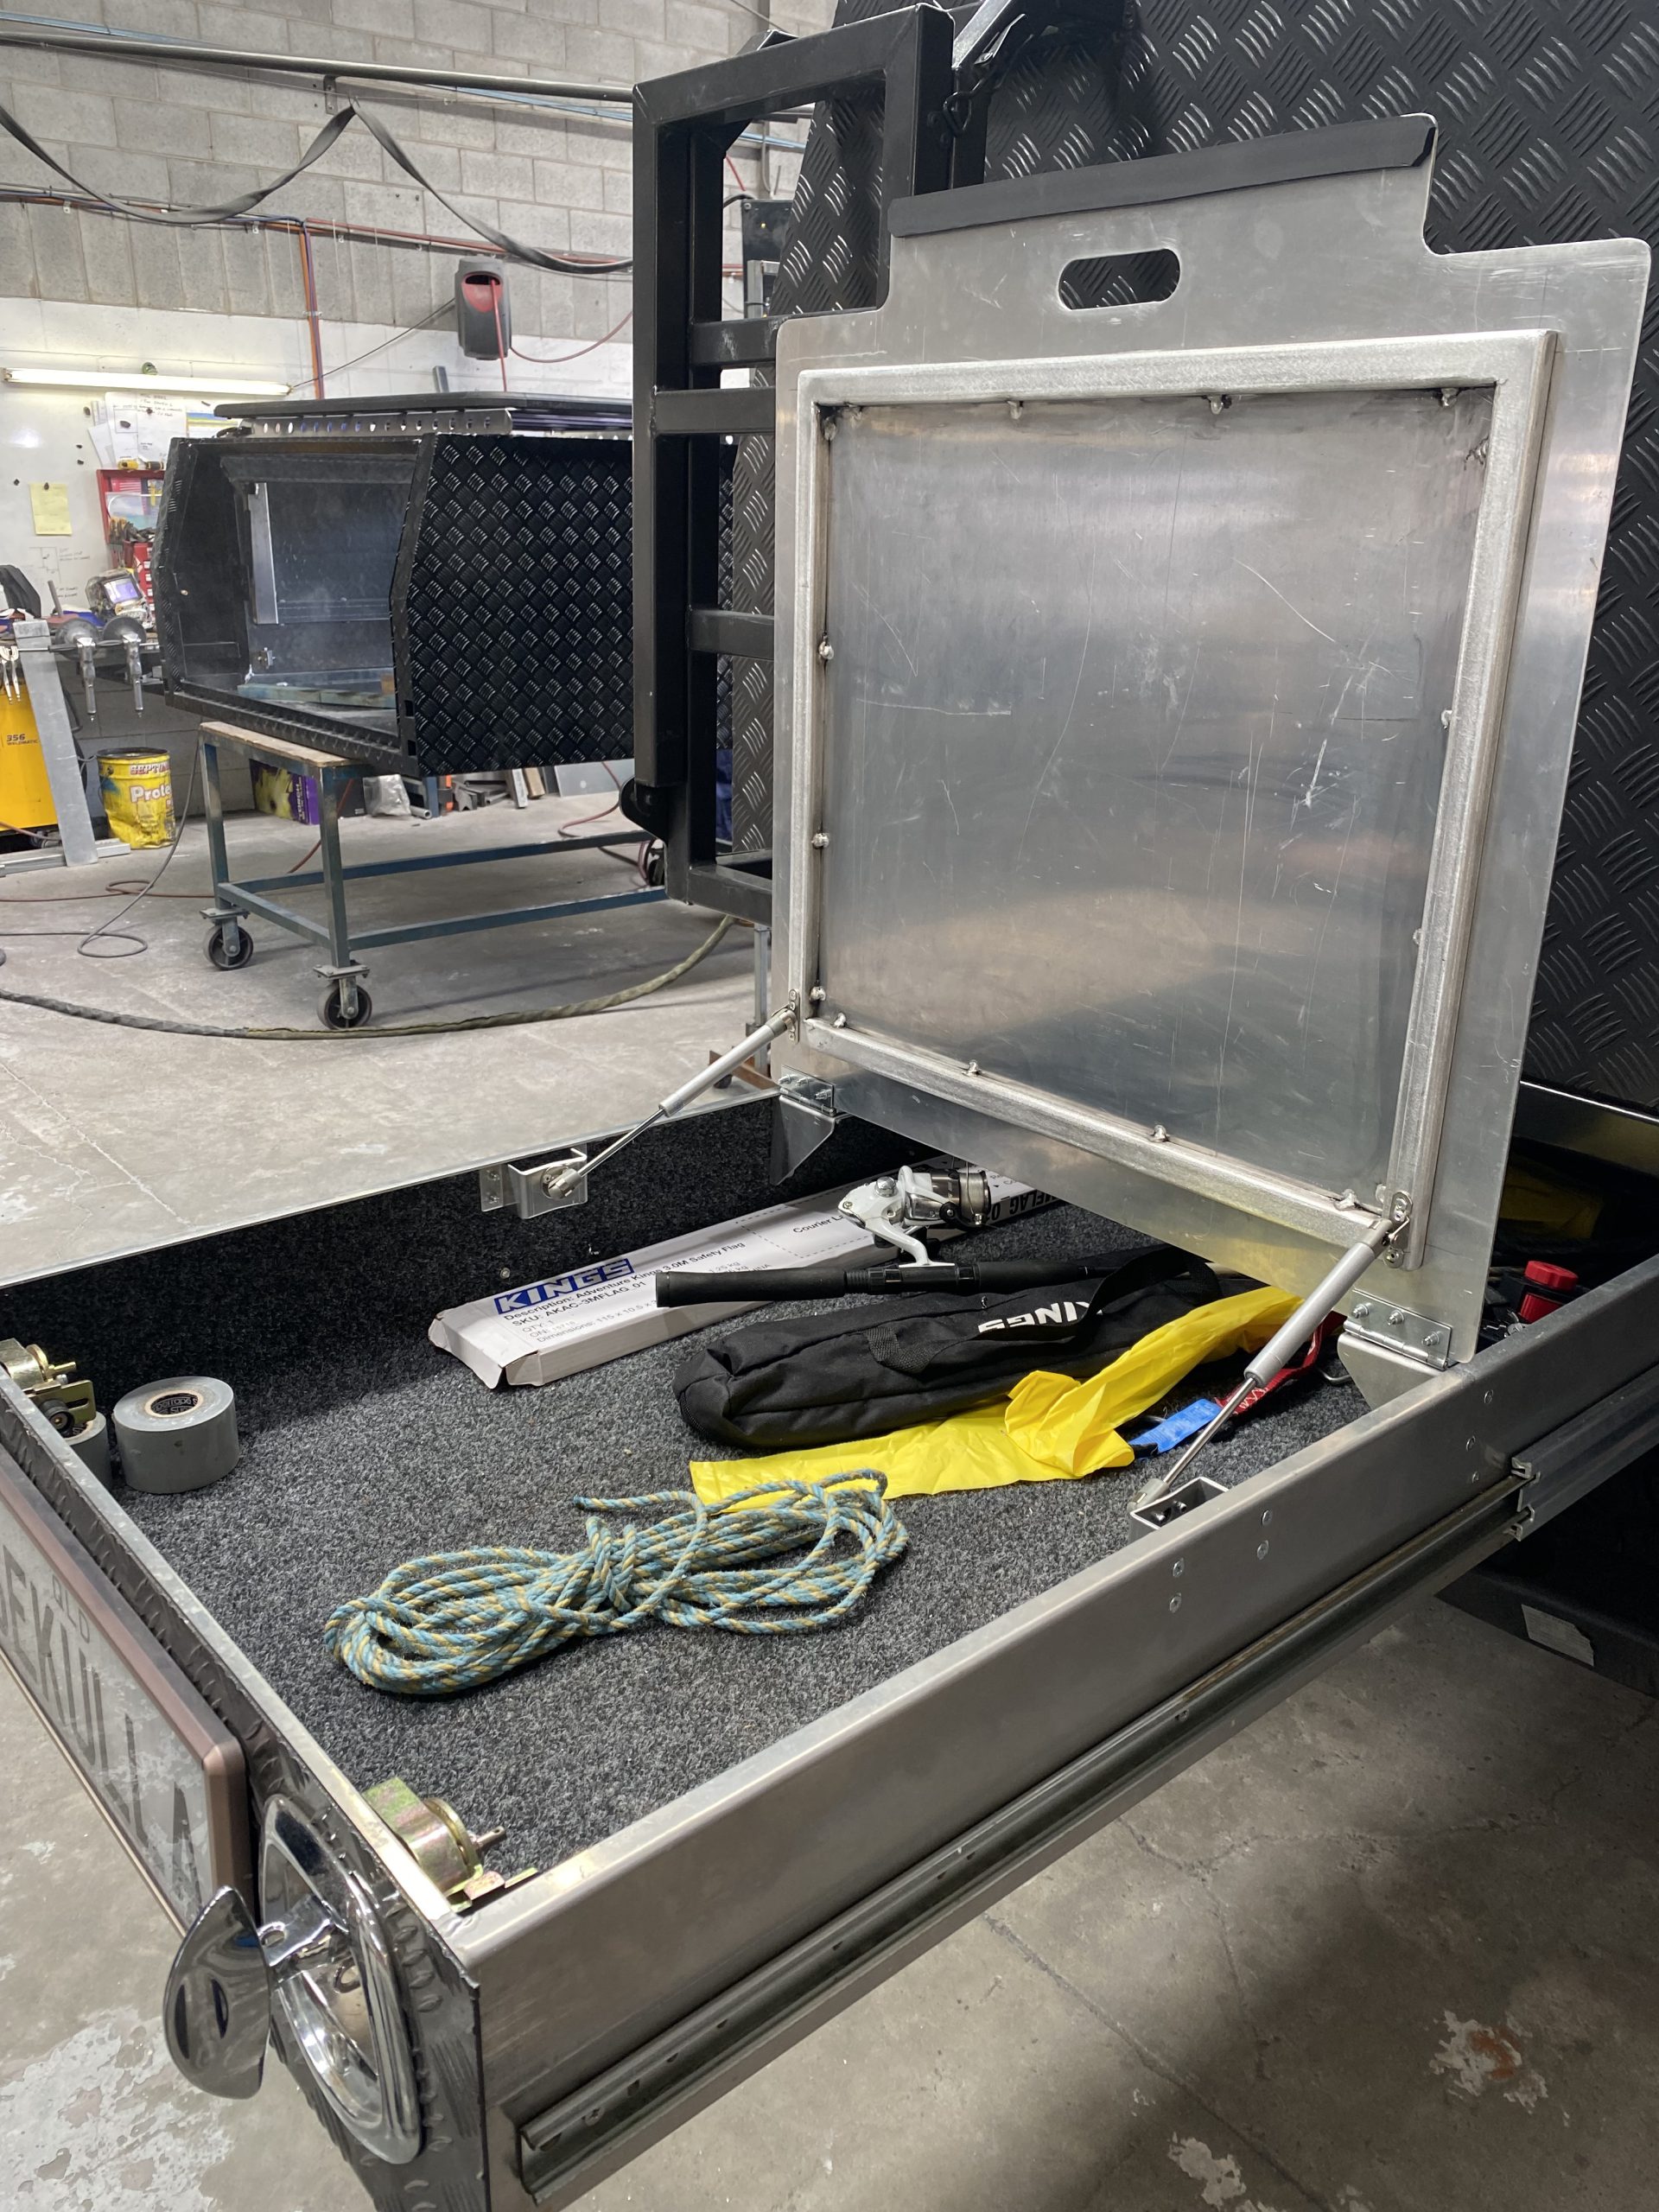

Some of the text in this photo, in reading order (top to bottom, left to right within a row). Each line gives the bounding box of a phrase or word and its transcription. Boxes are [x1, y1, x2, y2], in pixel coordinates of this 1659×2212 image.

[130, 785, 172, 804] Prote
[793, 1218, 832, 1233] Courier
[494, 1258, 634, 1314] KINGS
[504, 1242, 747, 1320] Description: Adventure Kings 3.0M Safety Flag
[512, 1313, 543, 1326] SKU:
[537, 1322, 596, 1342] Dimensions:
[52, 1573, 91, 1644] QLD
